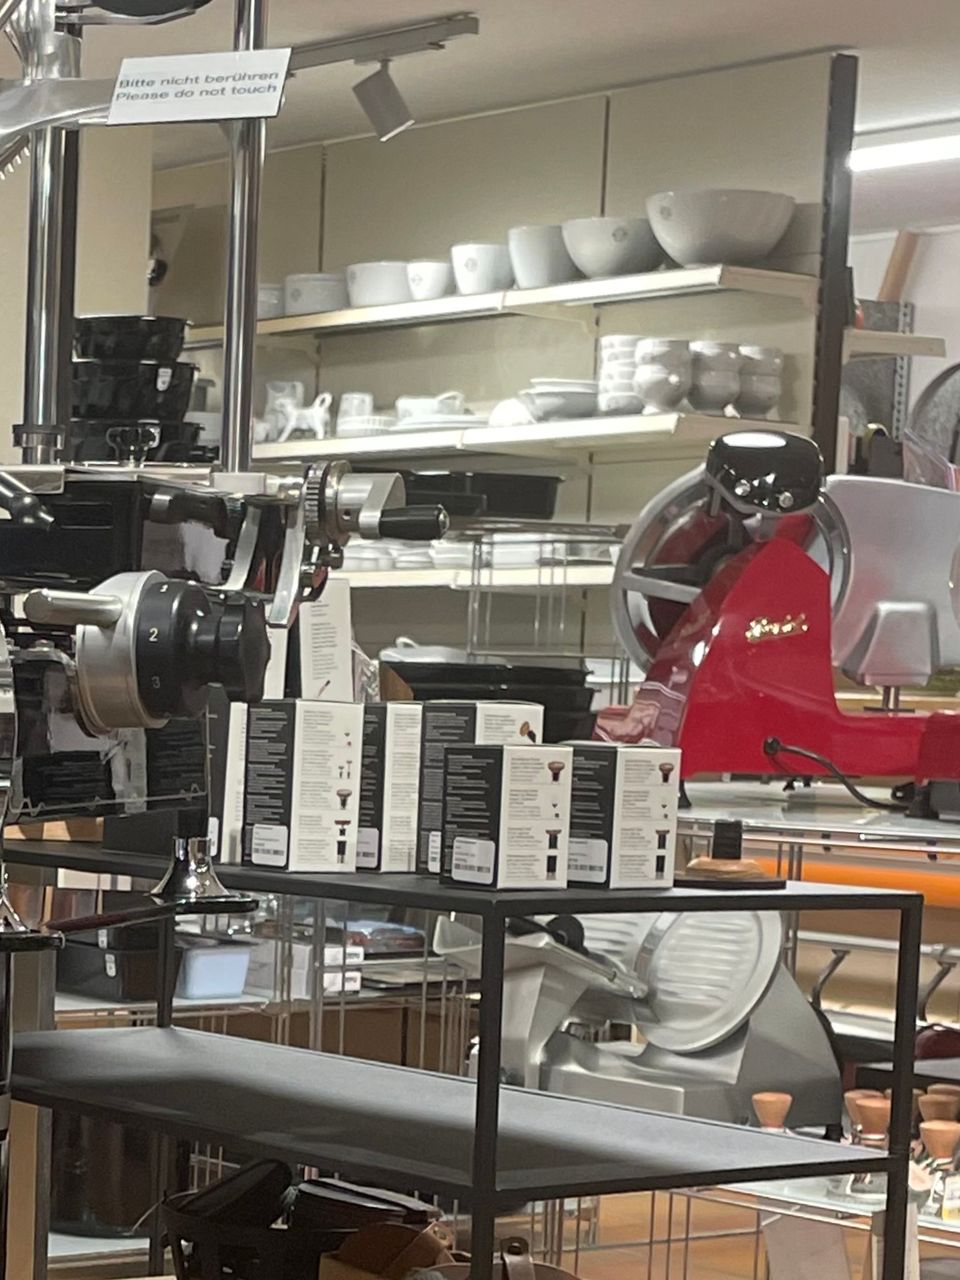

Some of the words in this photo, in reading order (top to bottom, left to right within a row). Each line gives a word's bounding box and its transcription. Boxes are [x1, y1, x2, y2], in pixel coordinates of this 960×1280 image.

[118, 78, 156, 88] Bitte
[160, 75, 200, 86] nicht
[204, 71, 279, 84] berühren
[116, 90, 169, 101] Please
[174, 88, 194, 98] do
[199, 87, 226, 97] not
[231, 84, 277, 95] touch
[148, 627, 159, 642] 2
[151, 675, 161, 689] 3
